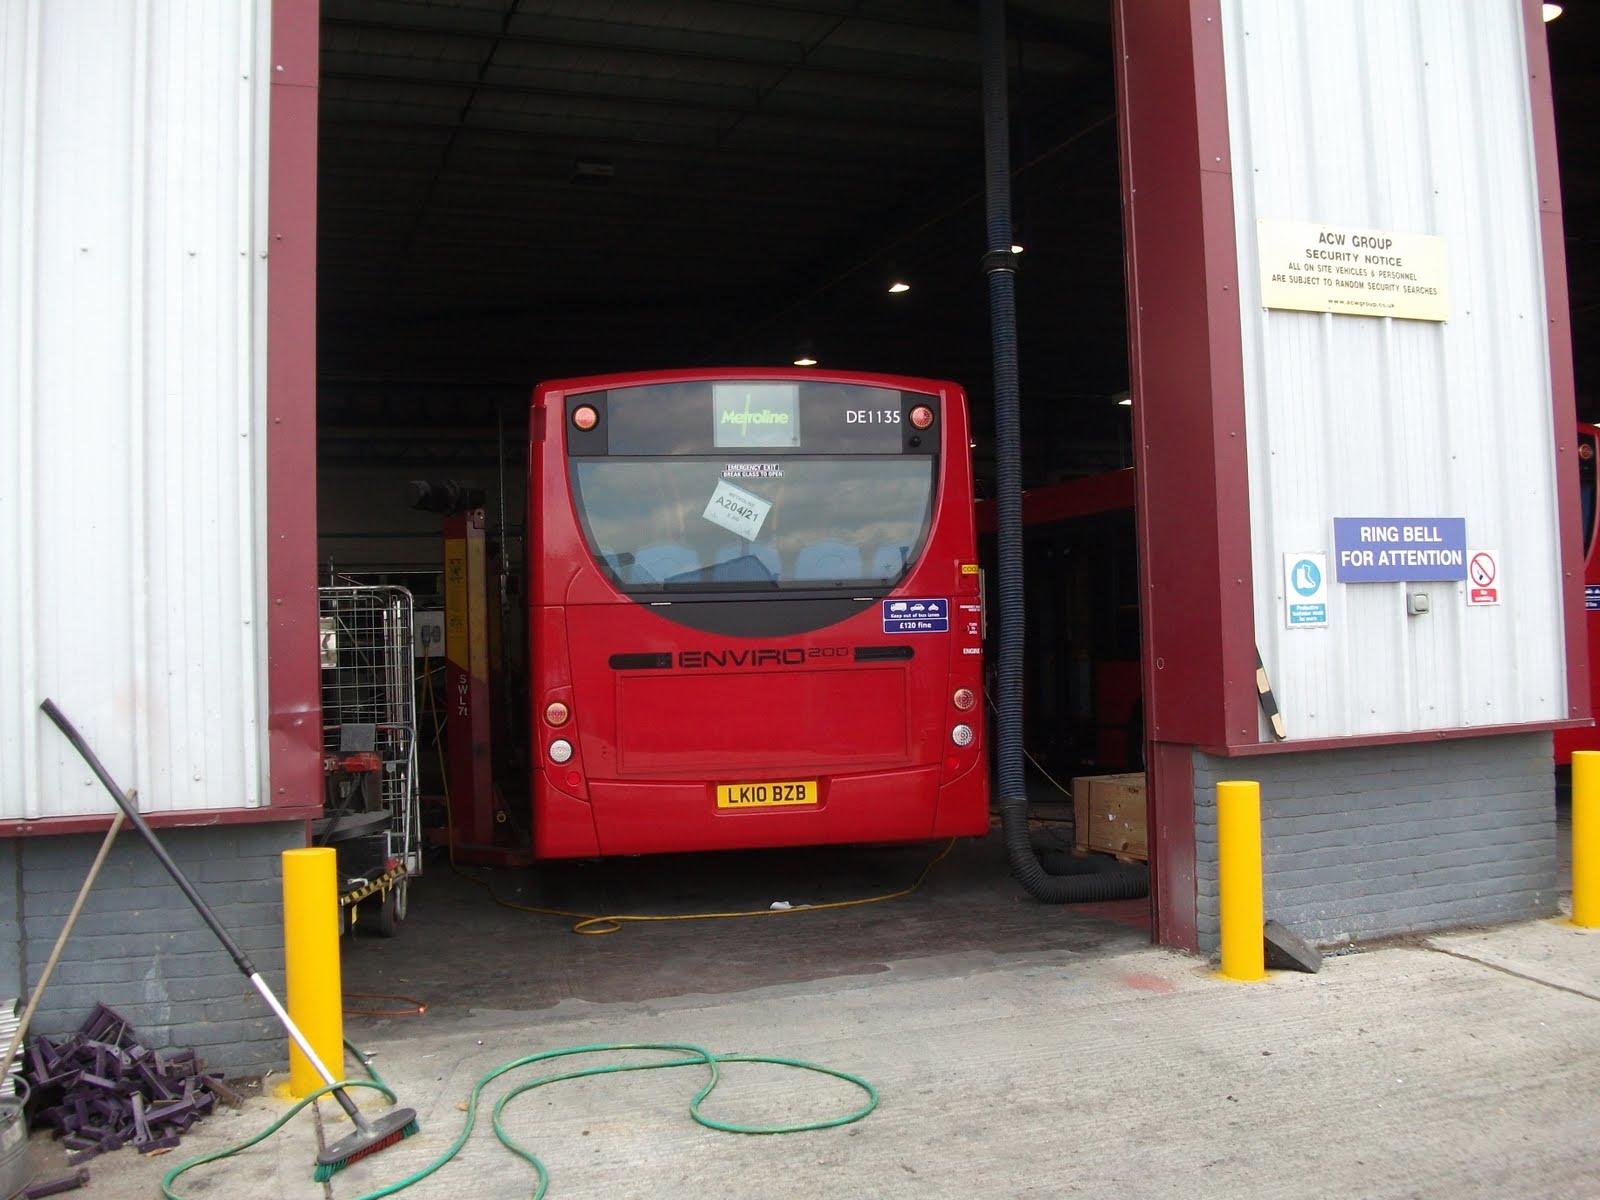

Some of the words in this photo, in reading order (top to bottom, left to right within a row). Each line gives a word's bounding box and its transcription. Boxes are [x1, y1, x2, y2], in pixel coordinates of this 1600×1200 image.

[1319, 232, 1346, 246] ACW
[1352, 235, 1393, 251] GROUP
[1305, 248, 1359, 263] SECURITY
[1364, 255, 1403, 267] NOTICE
[1288, 262, 1301, 271] ALL
[1304, 263, 1314, 272] ON
[1317, 264, 1332, 274] SITE
[1335, 266, 1368, 277] VEHICLES
[1370, 268, 1376, 278] &
[1378, 270, 1418, 282] PERSONNEL
[1271, 274, 1287, 283] ARE
[1289, 275, 1320, 286] SUBJECT
[1323, 277, 1333, 287] TO
[1335, 279, 1364, 290] RANDOM
[1367, 281, 1400, 293] SECURITY
[1402, 284, 1438, 296] SEARCHES
[1328, 298, 1395, 309] www.acwgroup.co.uk
[846, 410, 901, 424] DE1135
[715, 496, 759, 522] A204/21
[1360, 526, 1399, 542] RING
[1403, 526, 1443, 542] BELL
[1341, 550, 1374, 567] FOR
[1378, 549, 1462, 566] ATTENTION
[917, 621, 932, 629] fine
[678, 648, 806, 668] ENVIRO
[807, 647, 849, 658] 200
[728, 786, 767, 803] LK10
[772, 785, 806, 801] BZB
